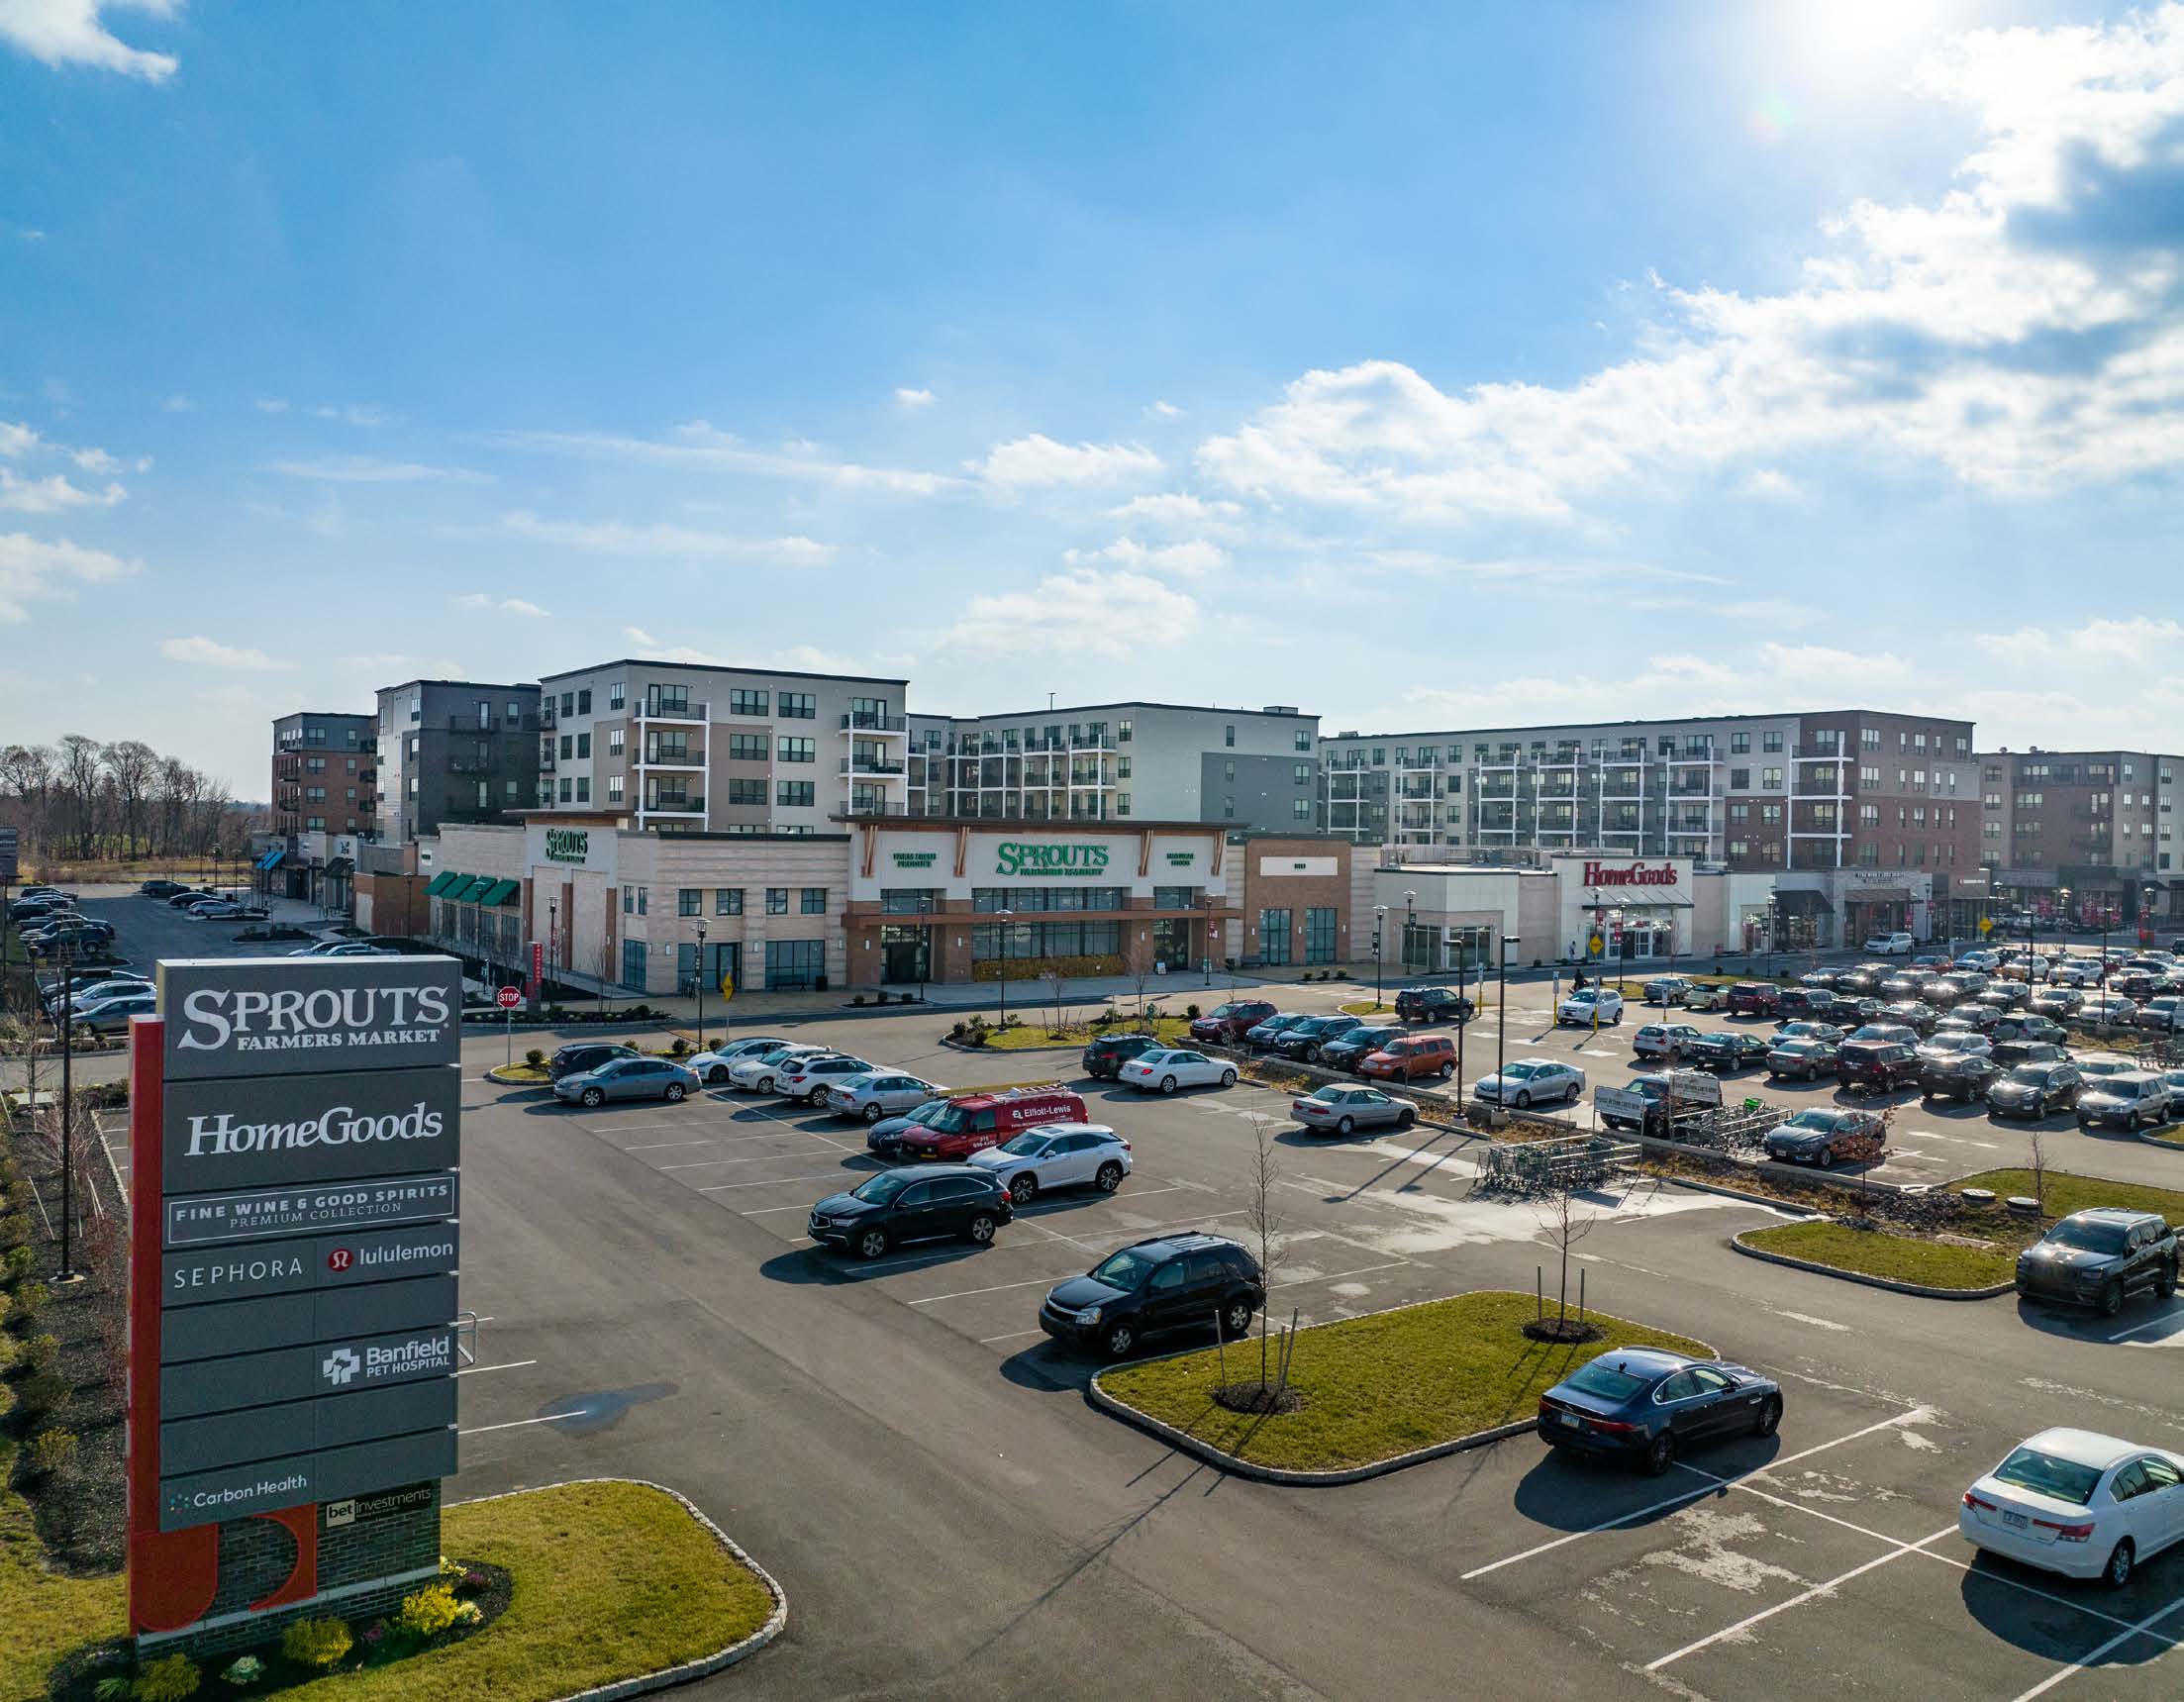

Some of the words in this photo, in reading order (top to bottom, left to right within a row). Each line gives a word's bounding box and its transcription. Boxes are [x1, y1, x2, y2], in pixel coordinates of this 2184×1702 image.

[996, 842, 1109, 875] SPROUTS
[1584, 862, 1678, 886] HomeGoods
[499, 993, 519, 1002] STOP
[177, 986, 449, 1051] SPROUTS
[238, 1033, 343, 1051] FARMERS
[347, 1029, 441, 1047] MARKET
[1025, 1105, 1071, 1118] Elliott-Lewis
[183, 1101, 444, 1156] HomeGoods
[176, 1205, 226, 1222] FINE
[236, 1199, 289, 1216] WINE
[298, 1197, 307, 1209] &
[316, 1192, 368, 1207] GOOD
[376, 1185, 448, 1201] SPIRITS
[230, 1212, 303, 1228] PREMIUM
[310, 1202, 402, 1220] COLLECTION
[359, 1243, 453, 1266] lululemon
[173, 1257, 303, 1288] SEPHORA
[366, 1336, 449, 1365] Banfield
[366, 1365, 389, 1377] PET
[392, 1356, 449, 1373] HOSPITAL
[194, 1487, 253, 1507] Carbon
[257, 1475, 307, 1496] Health
[328, 1505, 353, 1519] bet
[355, 1488, 432, 1514] investments
